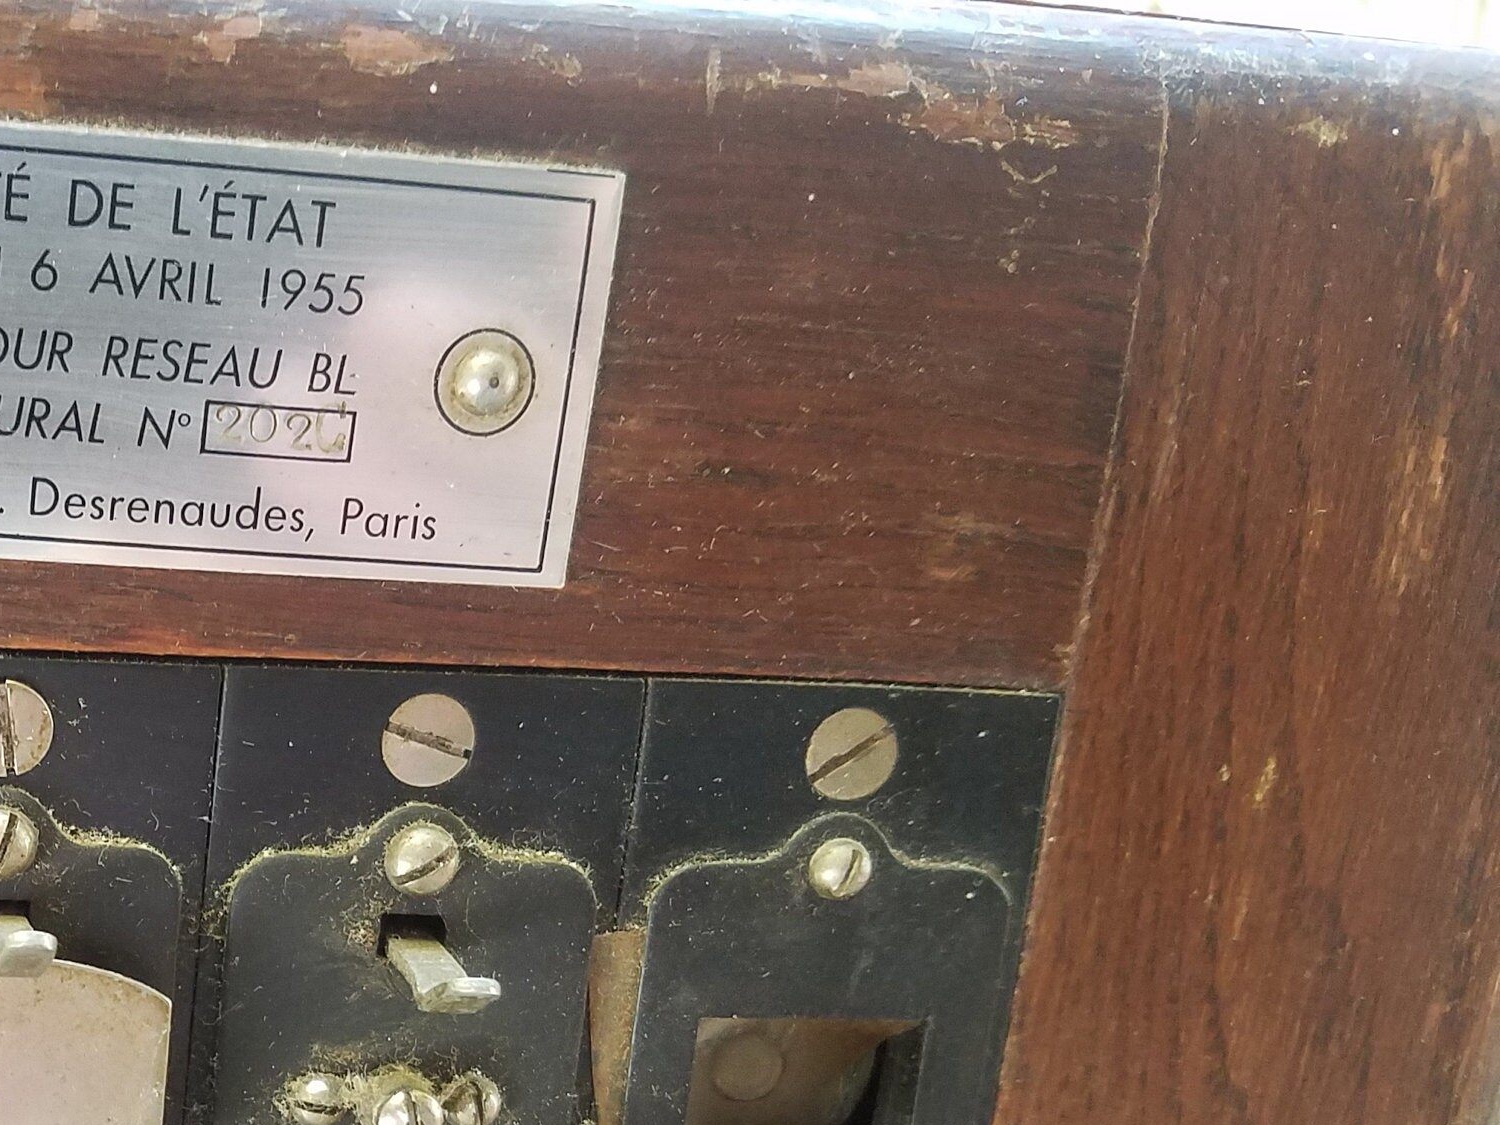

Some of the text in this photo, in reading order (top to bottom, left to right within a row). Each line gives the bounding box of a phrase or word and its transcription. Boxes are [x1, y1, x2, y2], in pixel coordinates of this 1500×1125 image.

[67, 178, 135, 231] DE
[171, 180, 337, 249] L'ÉTAT
[30, 248, 58, 292] 6
[88, 251, 222, 306] AVRIL
[260, 267, 365, 316] 1955
[101, 335, 283, 390] RESEAU
[29, 476, 314, 543] Desrenaudes,
[340, 497, 437, 541] Paris
